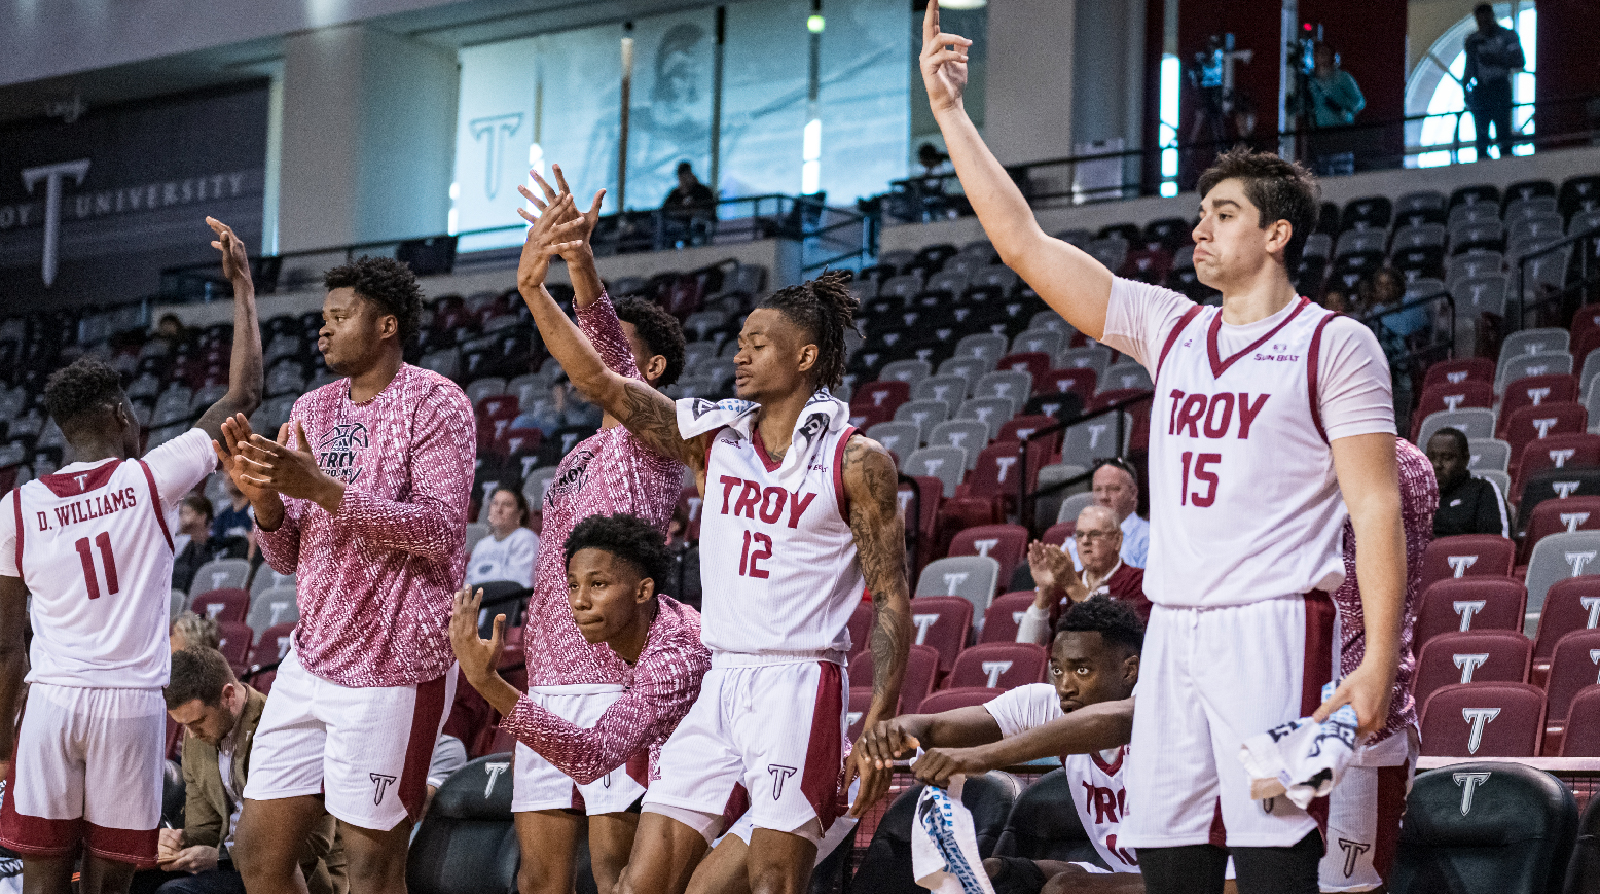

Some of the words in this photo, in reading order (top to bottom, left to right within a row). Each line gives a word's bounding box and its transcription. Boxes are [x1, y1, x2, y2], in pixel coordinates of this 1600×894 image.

[75, 172, 248, 218] UNIVERSITY
[1169, 388, 1272, 440] TROY
[719, 475, 818, 529] TROY
[1180, 451, 1222, 508] 15
[36, 510, 53, 532] D.
[53, 486, 138, 527] WILLIAMS
[74, 530, 120, 600] 11
[738, 530, 773, 579] 12
